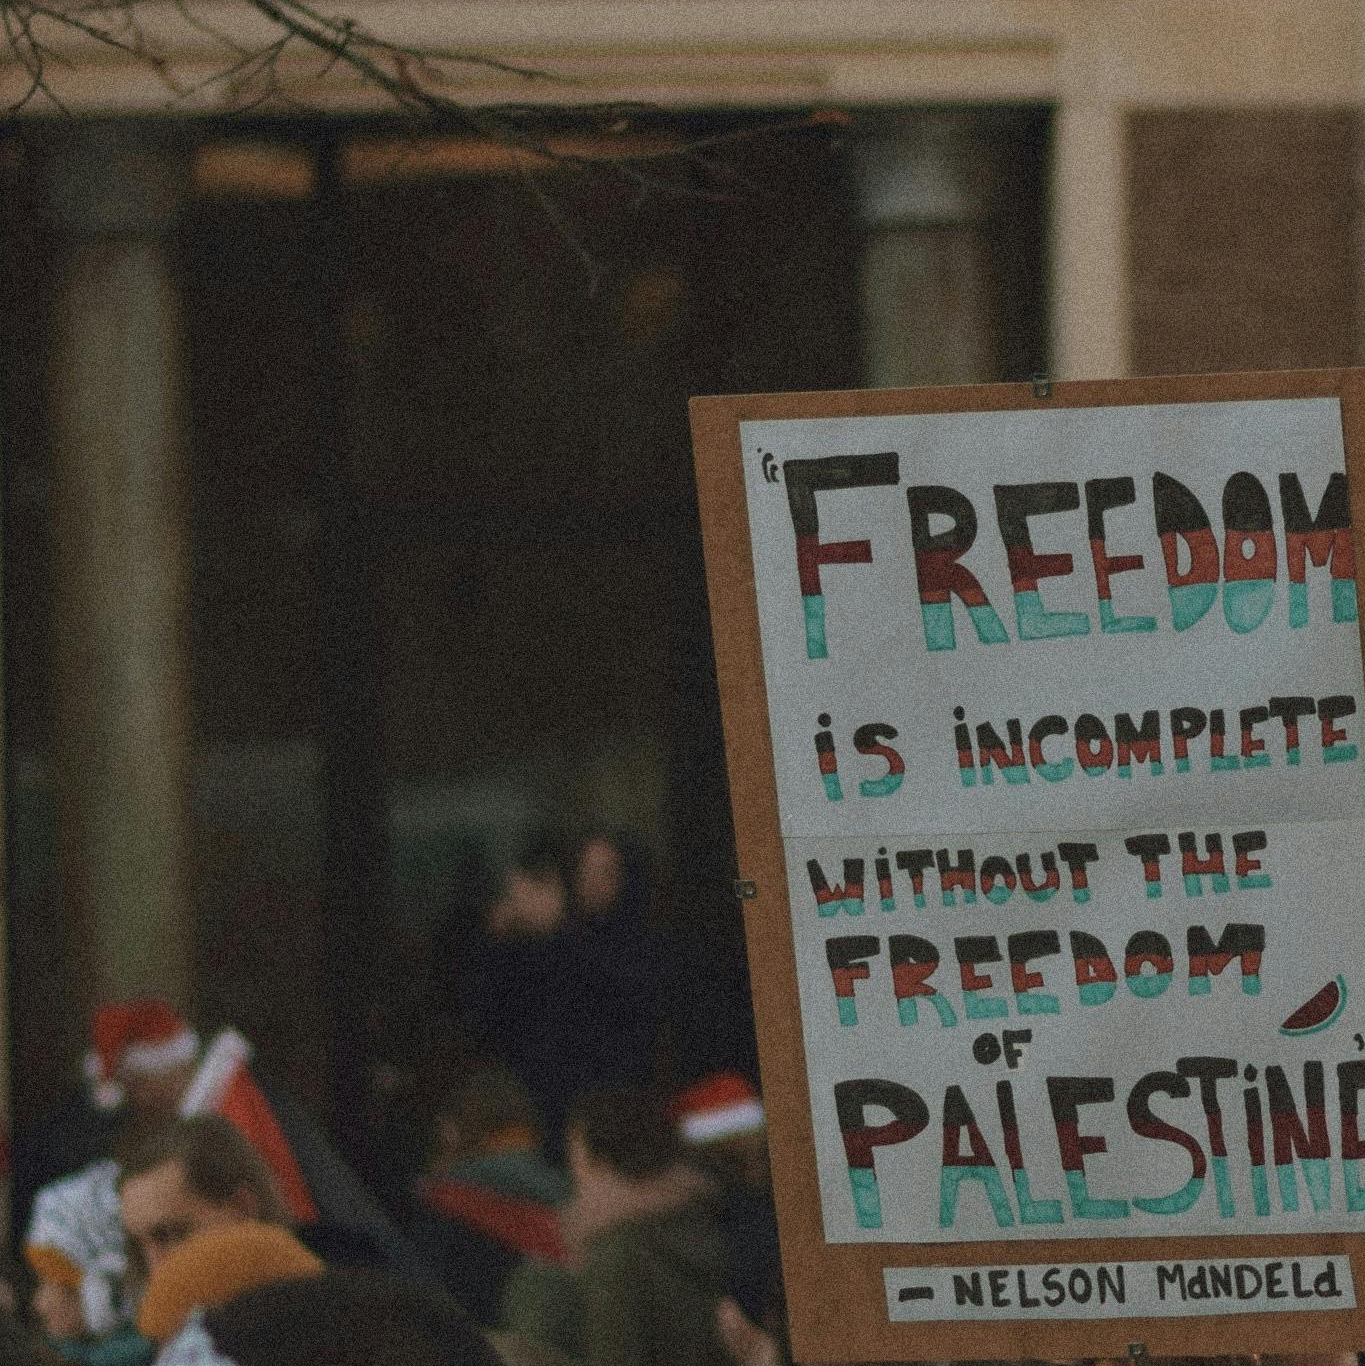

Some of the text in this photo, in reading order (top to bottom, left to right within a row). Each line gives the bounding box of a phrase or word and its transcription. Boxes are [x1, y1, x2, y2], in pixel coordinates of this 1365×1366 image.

[1124, 830, 1272, 900] THE
[825, 923, 1267, 1028] FREEDOM
[972, 1028, 1033, 1071] OF
[952, 1264, 1127, 1309] NELSON
